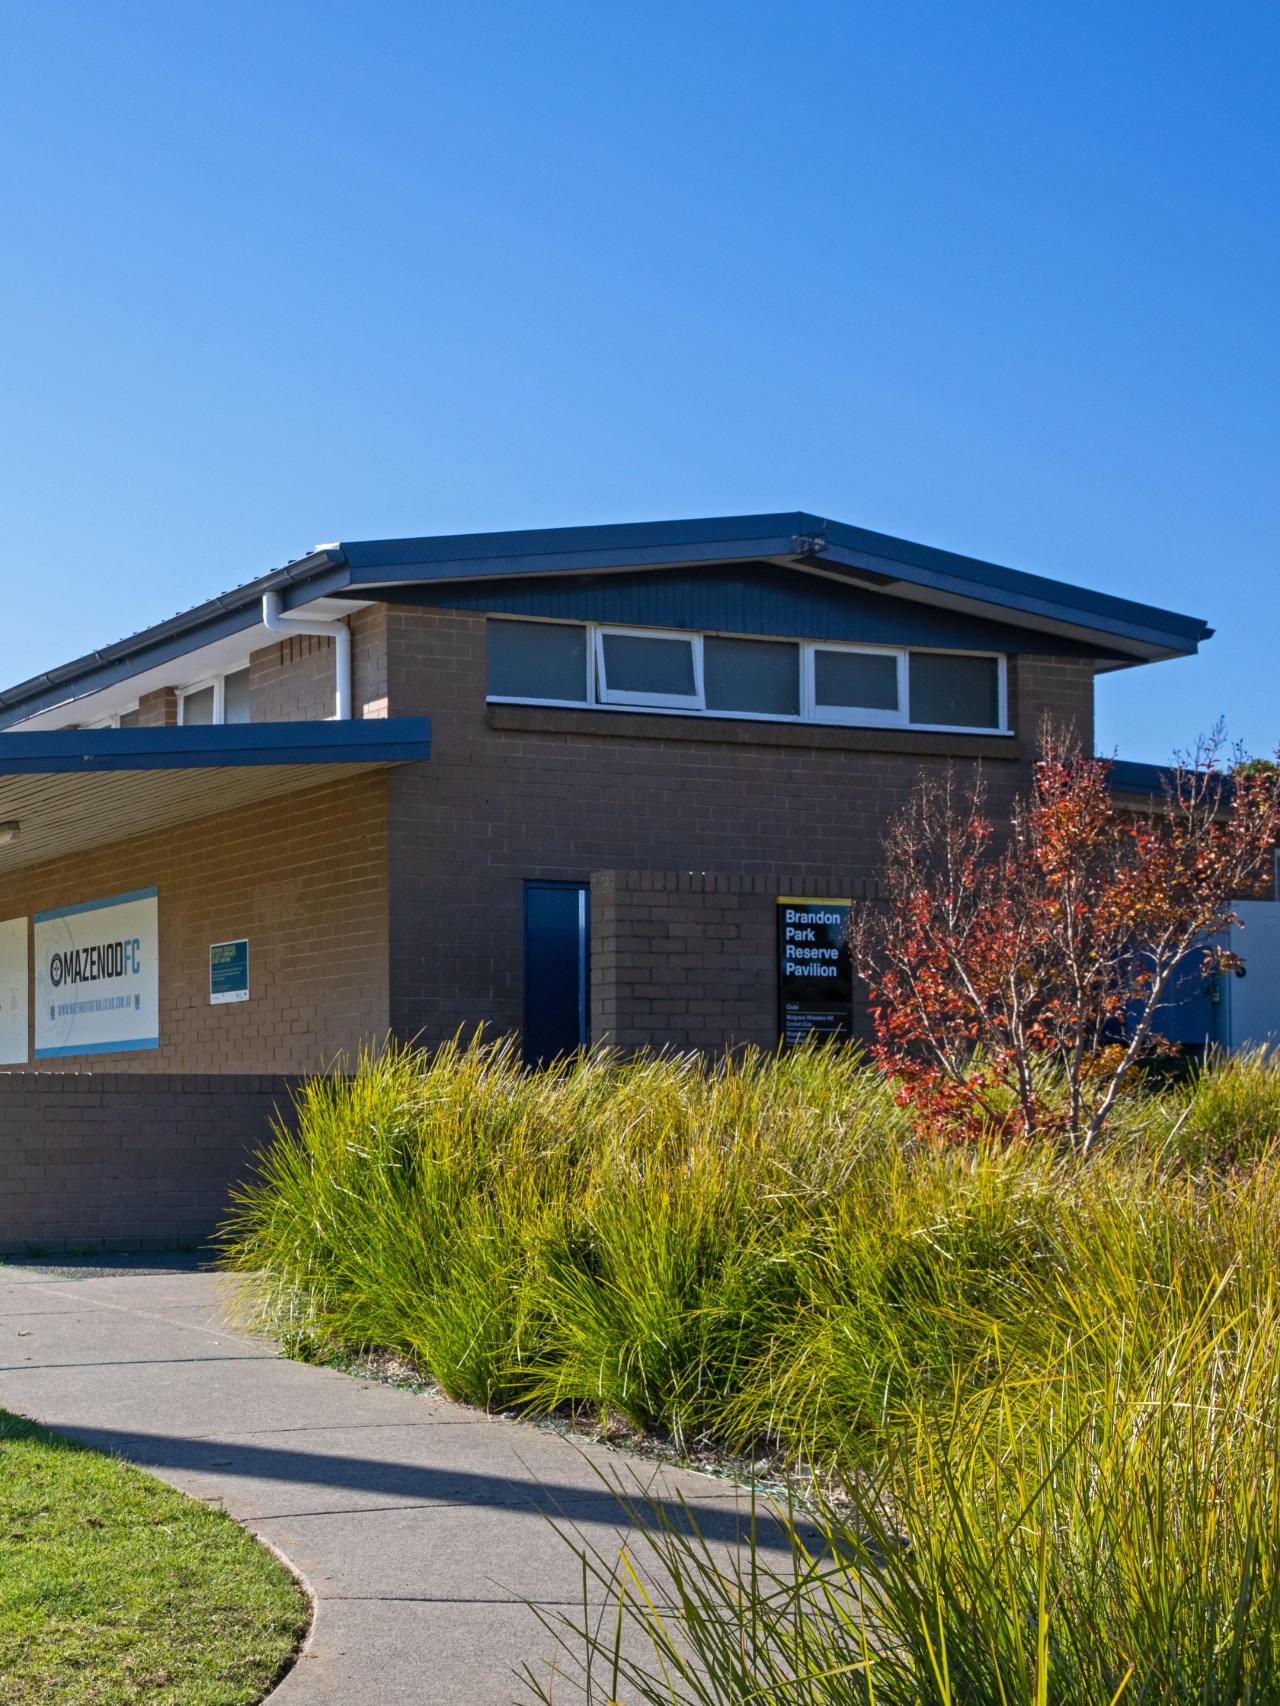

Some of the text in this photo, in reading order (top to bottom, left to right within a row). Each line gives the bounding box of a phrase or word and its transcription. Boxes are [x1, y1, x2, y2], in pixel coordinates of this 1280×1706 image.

[785, 909, 841, 924] Brandon
[786, 927, 815, 941] Park
[786, 945, 839, 959] Reserve
[786, 962, 837, 977] Pavilion
